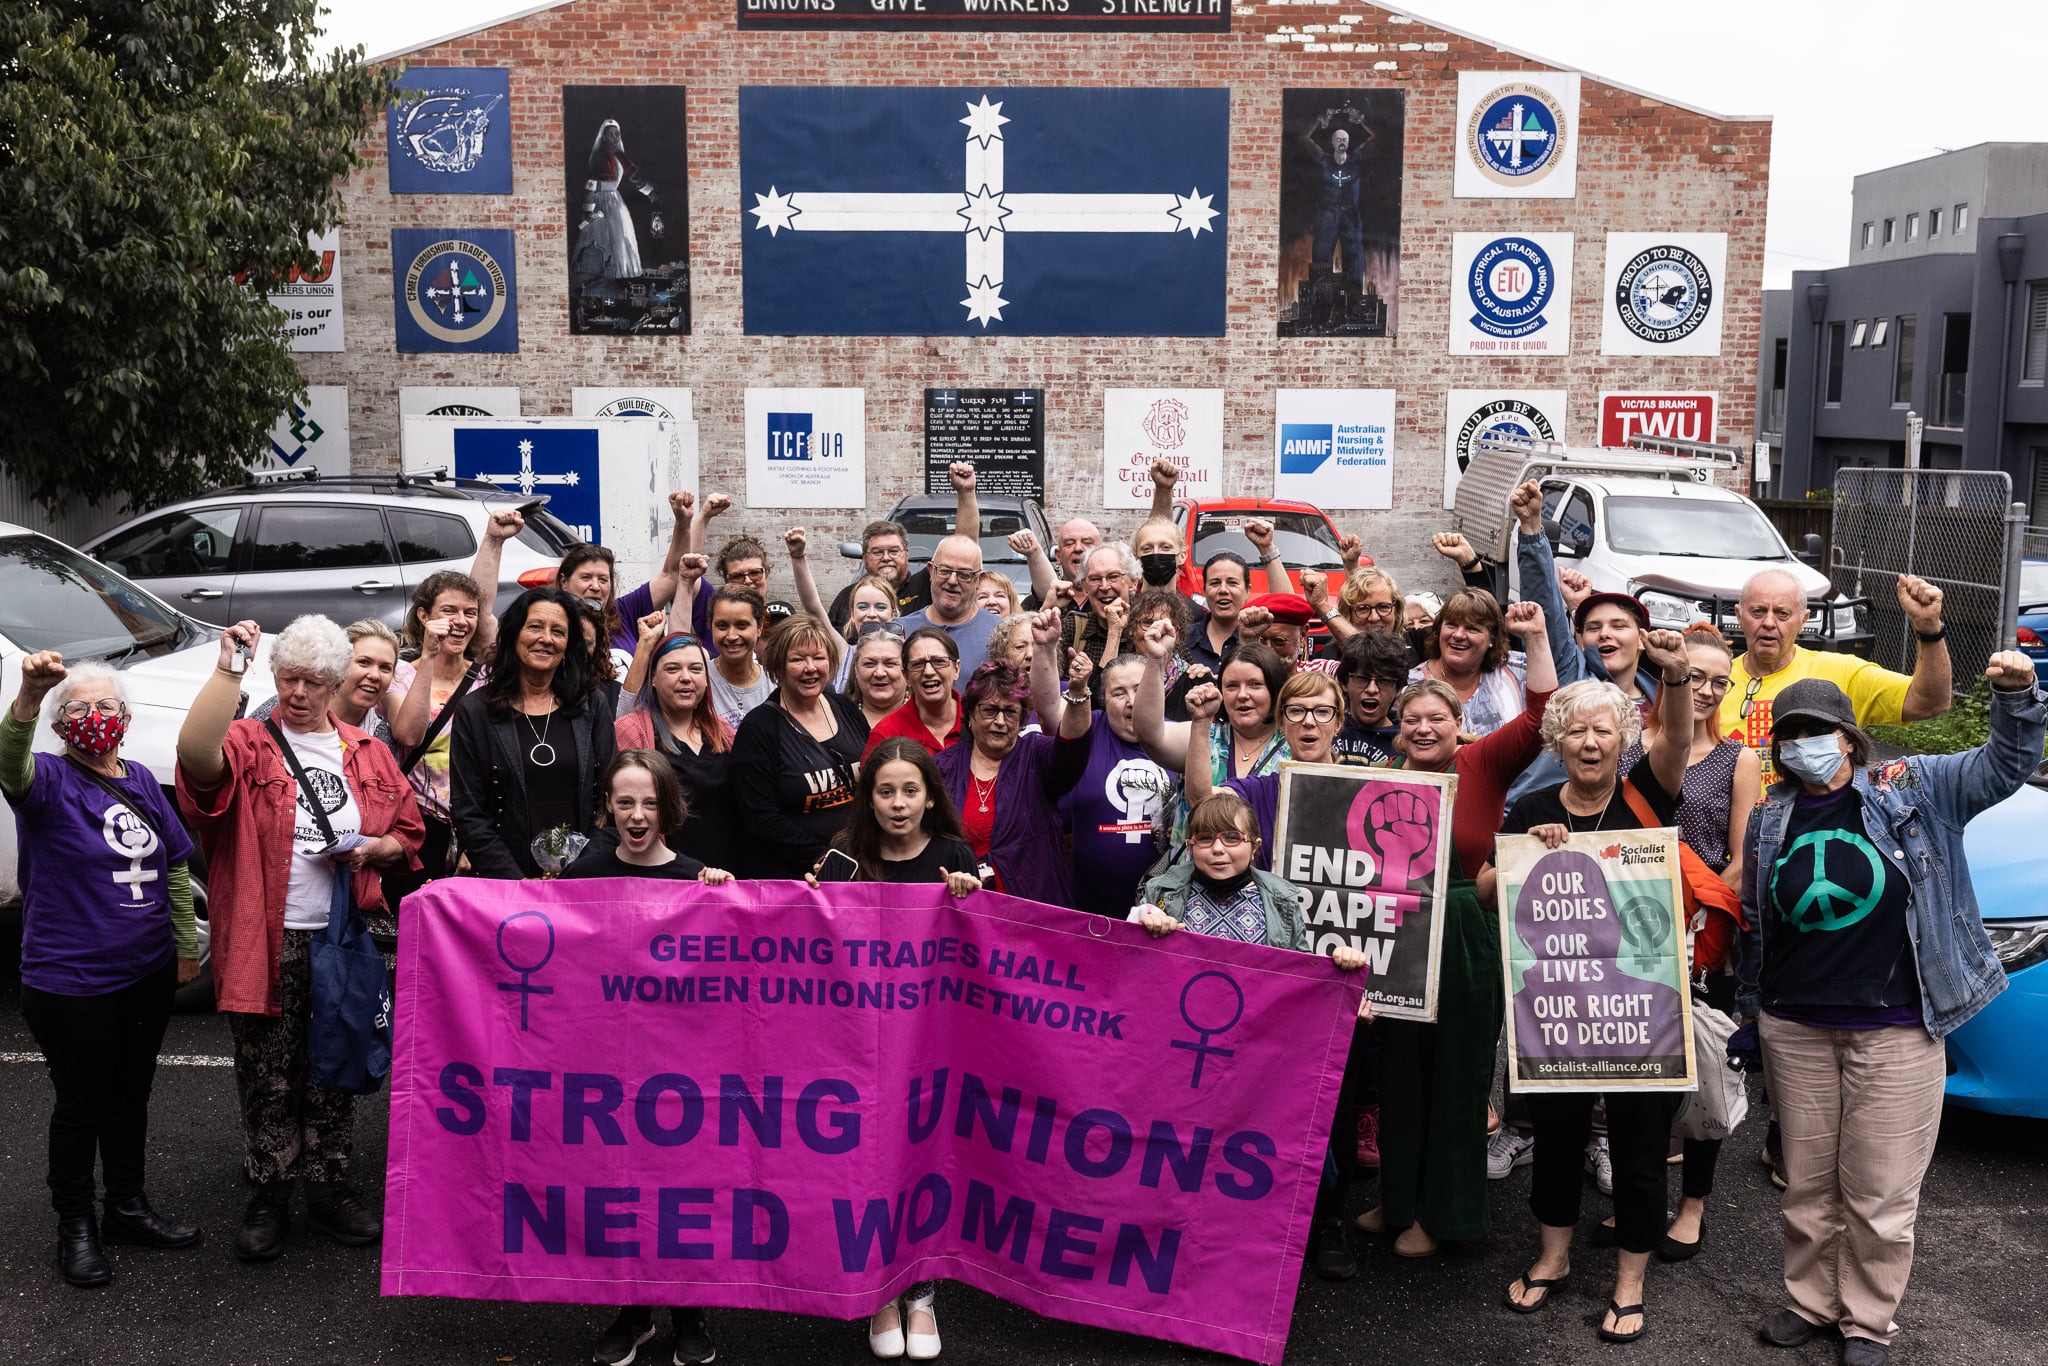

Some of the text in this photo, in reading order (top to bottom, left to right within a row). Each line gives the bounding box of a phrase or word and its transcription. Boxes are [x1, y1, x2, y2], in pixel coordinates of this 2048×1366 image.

[1480, 85, 1515, 110] FORESTRY
[1524, 85, 1551, 103] MINING
[1554, 109, 1566, 142] ENERGY
[1468, 110, 1485, 169] CONSTRUCTION
[1547, 144, 1563, 168] UNION
[406, 241, 506, 302] CFMEU FURNISHING TRADES DIVISION
[1474, 242, 1548, 298] ELECTRICAL TRADES UNION
[1497, 266, 1525, 293] ETU
[1620, 248, 1710, 289] PROUD TO BE UNION
[1643, 263, 1670, 277] UNION
[1672, 265, 1683, 273] OF
[306, 286, 334, 295] UNION
[291, 308, 332, 320] is our
[1481, 296, 1543, 318] OF AUSTRALIA
[1480, 320, 1540, 336] VICTORIAN BRANCH
[1620, 302, 1708, 340] GEELONG BRANCH
[1470, 341, 1548, 350] PROUD TO BE UNION
[617, 400, 656, 413] BUILDERS
[1620, 399, 1697, 409] VIC/TAS BRANCH
[1337, 425, 1386, 433] Australian
[1457, 401, 1555, 458] PROUD TO BE UNI
[1615, 411, 1702, 443] TWU
[772, 431, 843, 458] TCF UA
[1284, 439, 1331, 455] ANMF
[1337, 436, 1384, 445] Nursing &
[1337, 446, 1384, 456] Midwifery
[1337, 457, 1387, 466] Federation
[1118, 468, 1208, 482] Trad Hall
[1131, 485, 1188, 498] Cocil
[295, 827, 355, 837] TERNAONAL
[1621, 844, 1665, 856] Socialist
[1622, 855, 1665, 865] Alliance
[1289, 844, 1376, 887] END
[1541, 872, 1585, 895] OUR
[1296, 886, 1398, 933] RAPE
[1532, 898, 1607, 922] BODIES
[1545, 933, 1590, 956] OUR
[649, 934, 1086, 992] GEELONG TRADES HALL
[1543, 960, 1604, 983] LIVES
[601, 974, 1127, 1041] WOMEN UNIONIST NETWORK
[1364, 989, 1423, 1006] left.org.au
[1534, 994, 1653, 1018] OUR RIGHT
[1540, 1022, 1651, 1046] TO DECIDE
[1539, 1061, 1662, 1074] socialist-alliance.org
[435, 1061, 1278, 1201] STRONG UNIONS
[503, 1172, 1182, 1296] NEED WOMEN
